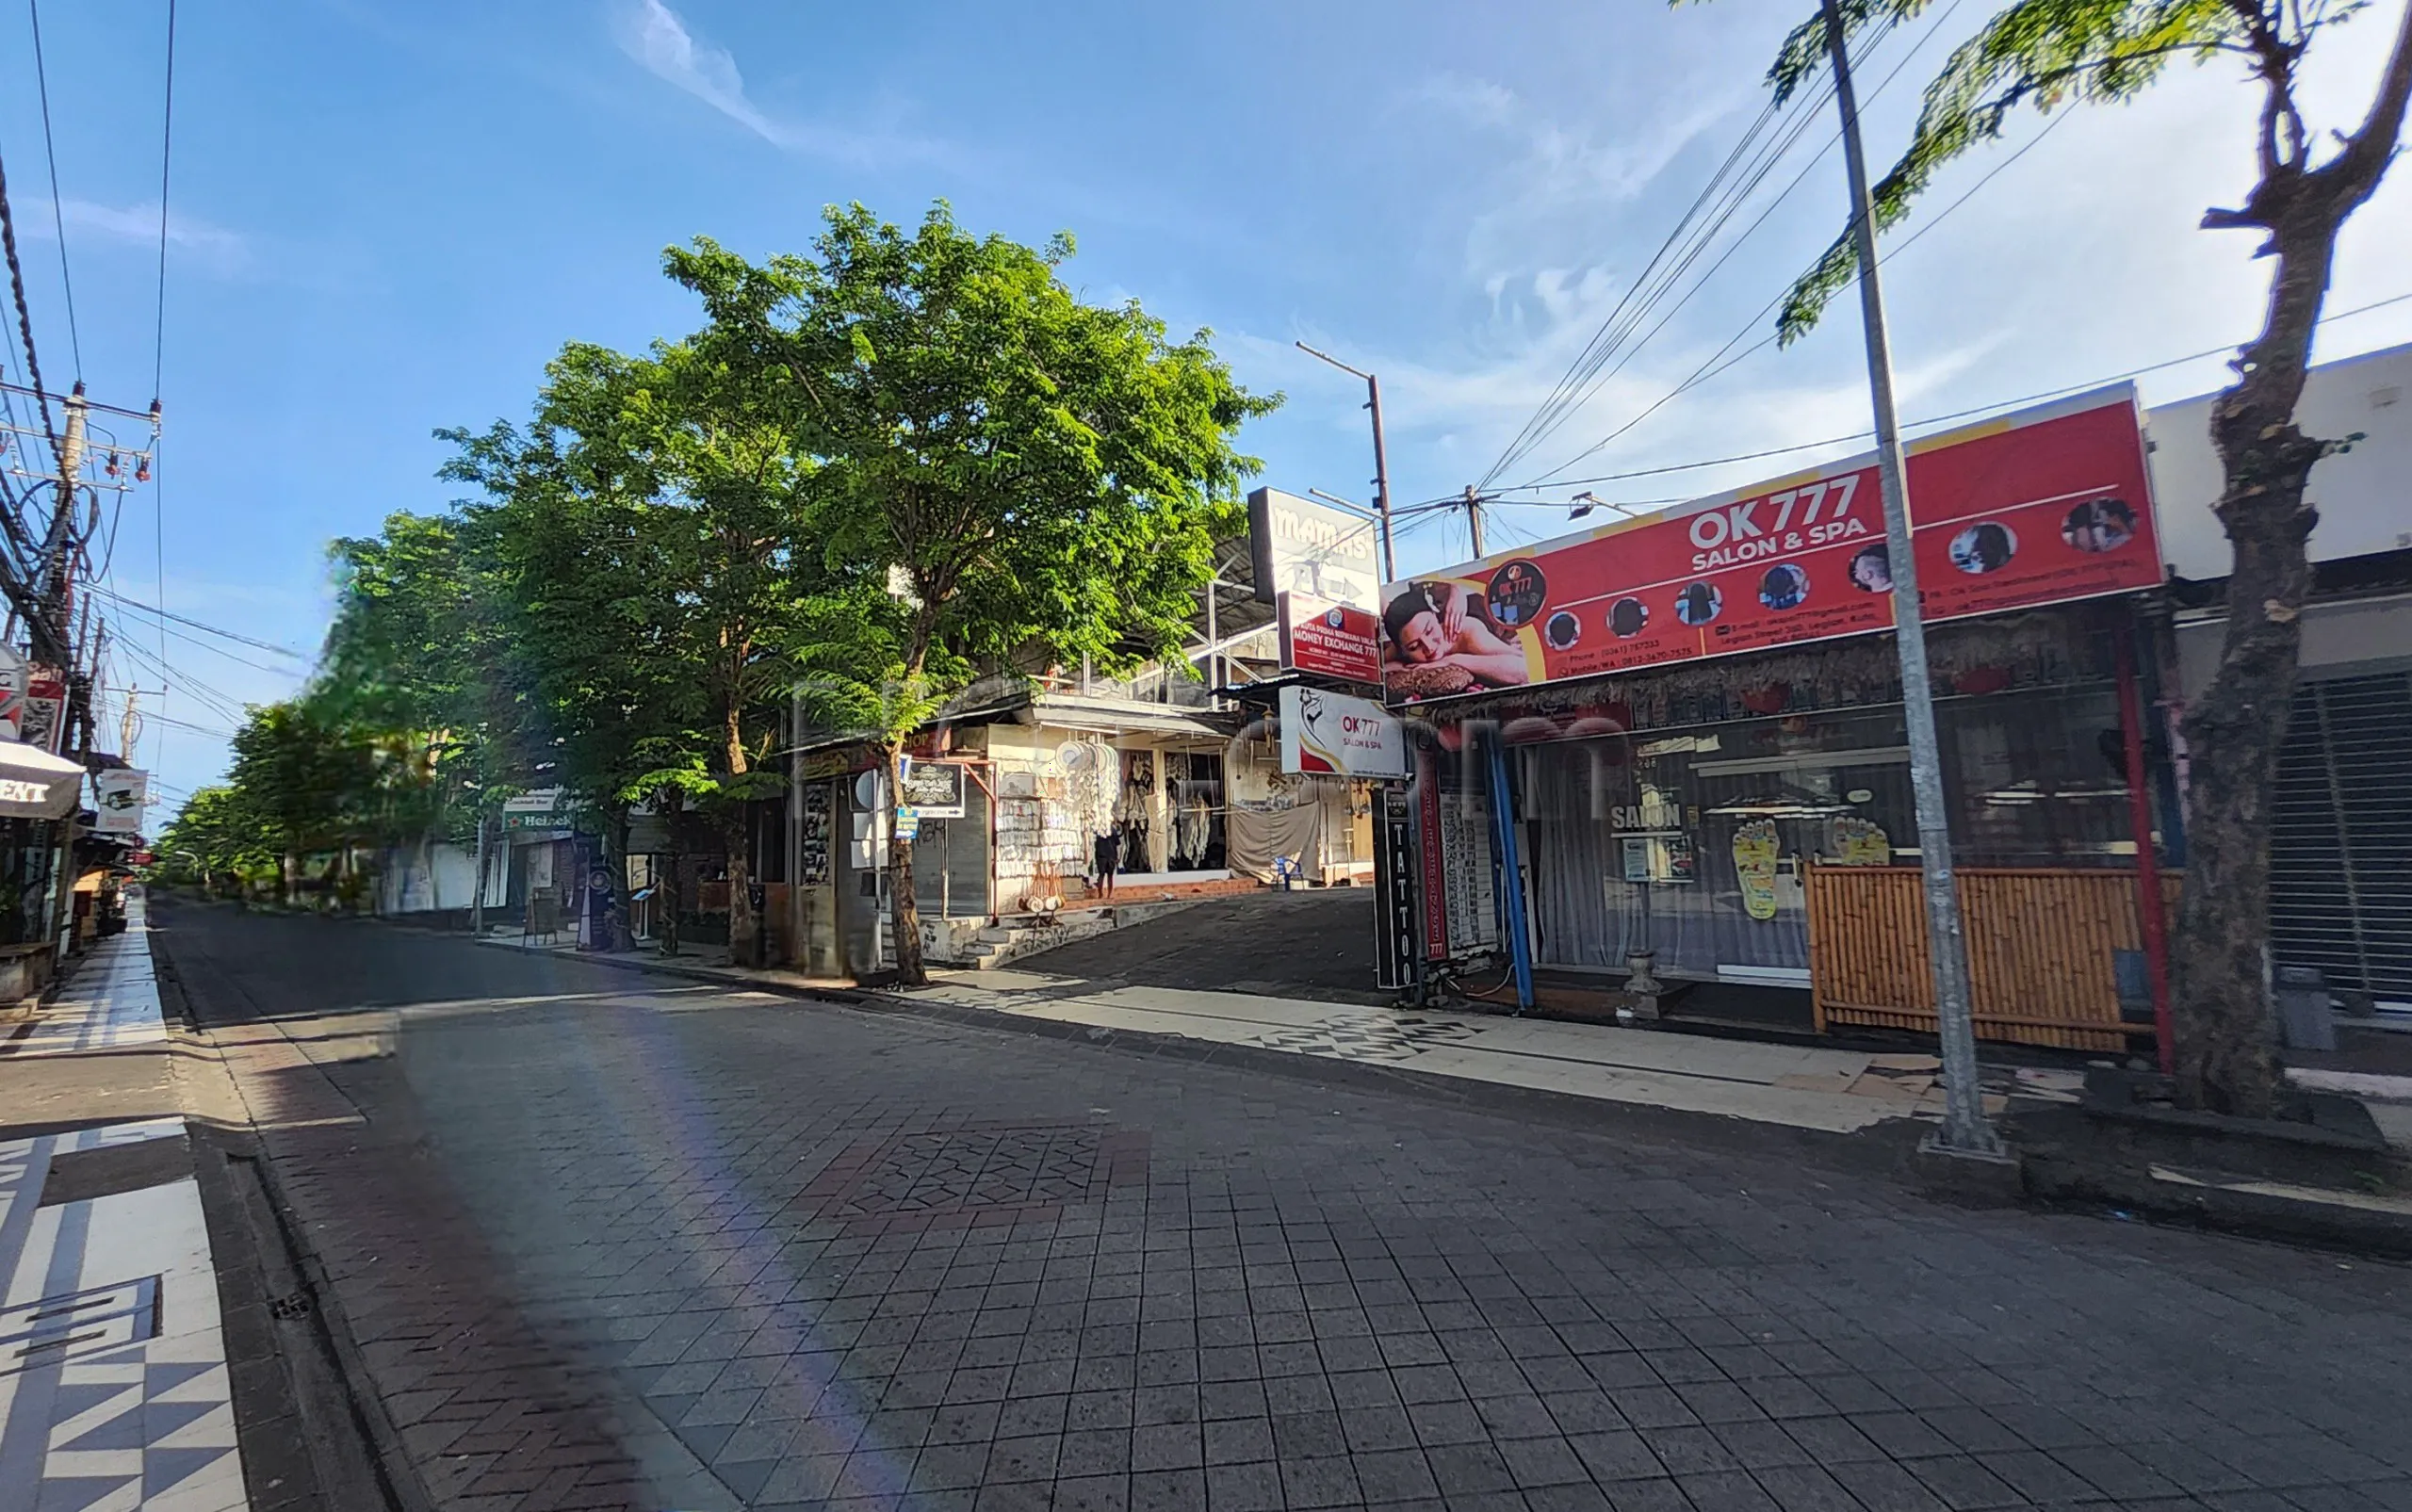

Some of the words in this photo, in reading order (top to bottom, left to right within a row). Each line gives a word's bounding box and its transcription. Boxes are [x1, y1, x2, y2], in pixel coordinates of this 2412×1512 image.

[1689, 501, 1763, 549] OK
[1768, 474, 1860, 532] 777
[1691, 537, 1777, 571] SALON
[1784, 532, 1803, 550] &
[1808, 518, 1867, 545] SPA
[1294, 628, 1323, 645] MONEY
[1324, 637, 1363, 655] EXCHANGE
[1364, 645, 1377, 658] 777
[1343, 715, 1361, 734] OK
[1361, 718, 1380, 736] 777
[1343, 738, 1364, 748] SALON
[1364, 739, 1370, 749] &
[1370, 740, 1382, 750] SPA
[1610, 804, 1681, 829] SALON
[1393, 823, 1411, 985] TATTOO
